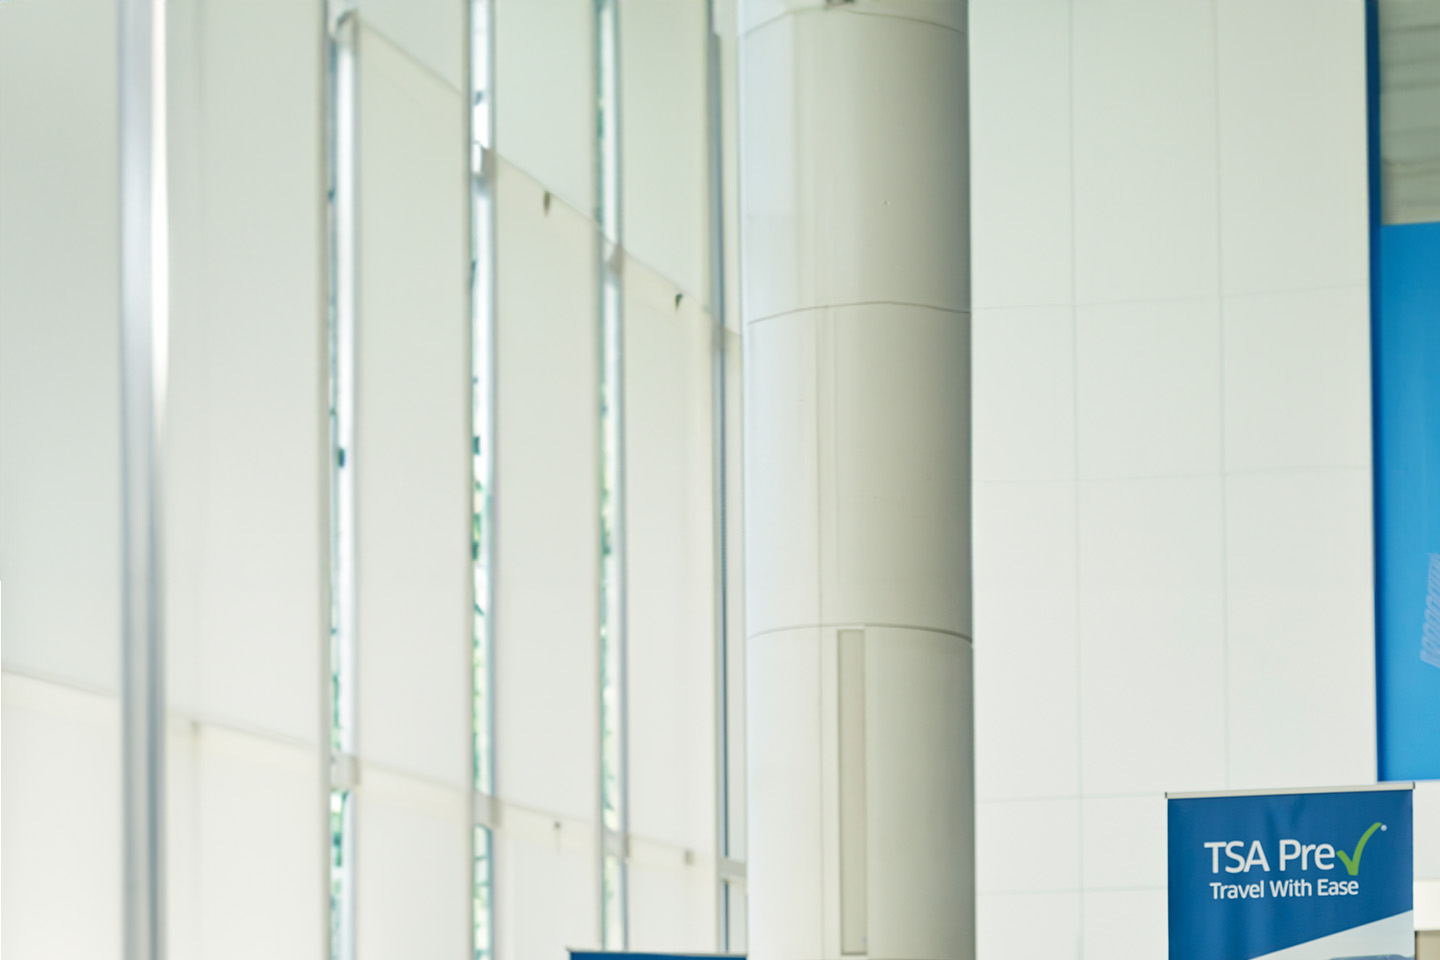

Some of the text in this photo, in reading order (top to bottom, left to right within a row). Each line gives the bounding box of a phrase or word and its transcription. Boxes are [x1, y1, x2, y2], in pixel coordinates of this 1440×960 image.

[1204, 839, 1335, 874] TSA Pre
[1209, 878, 1359, 899] Travel With Ease
